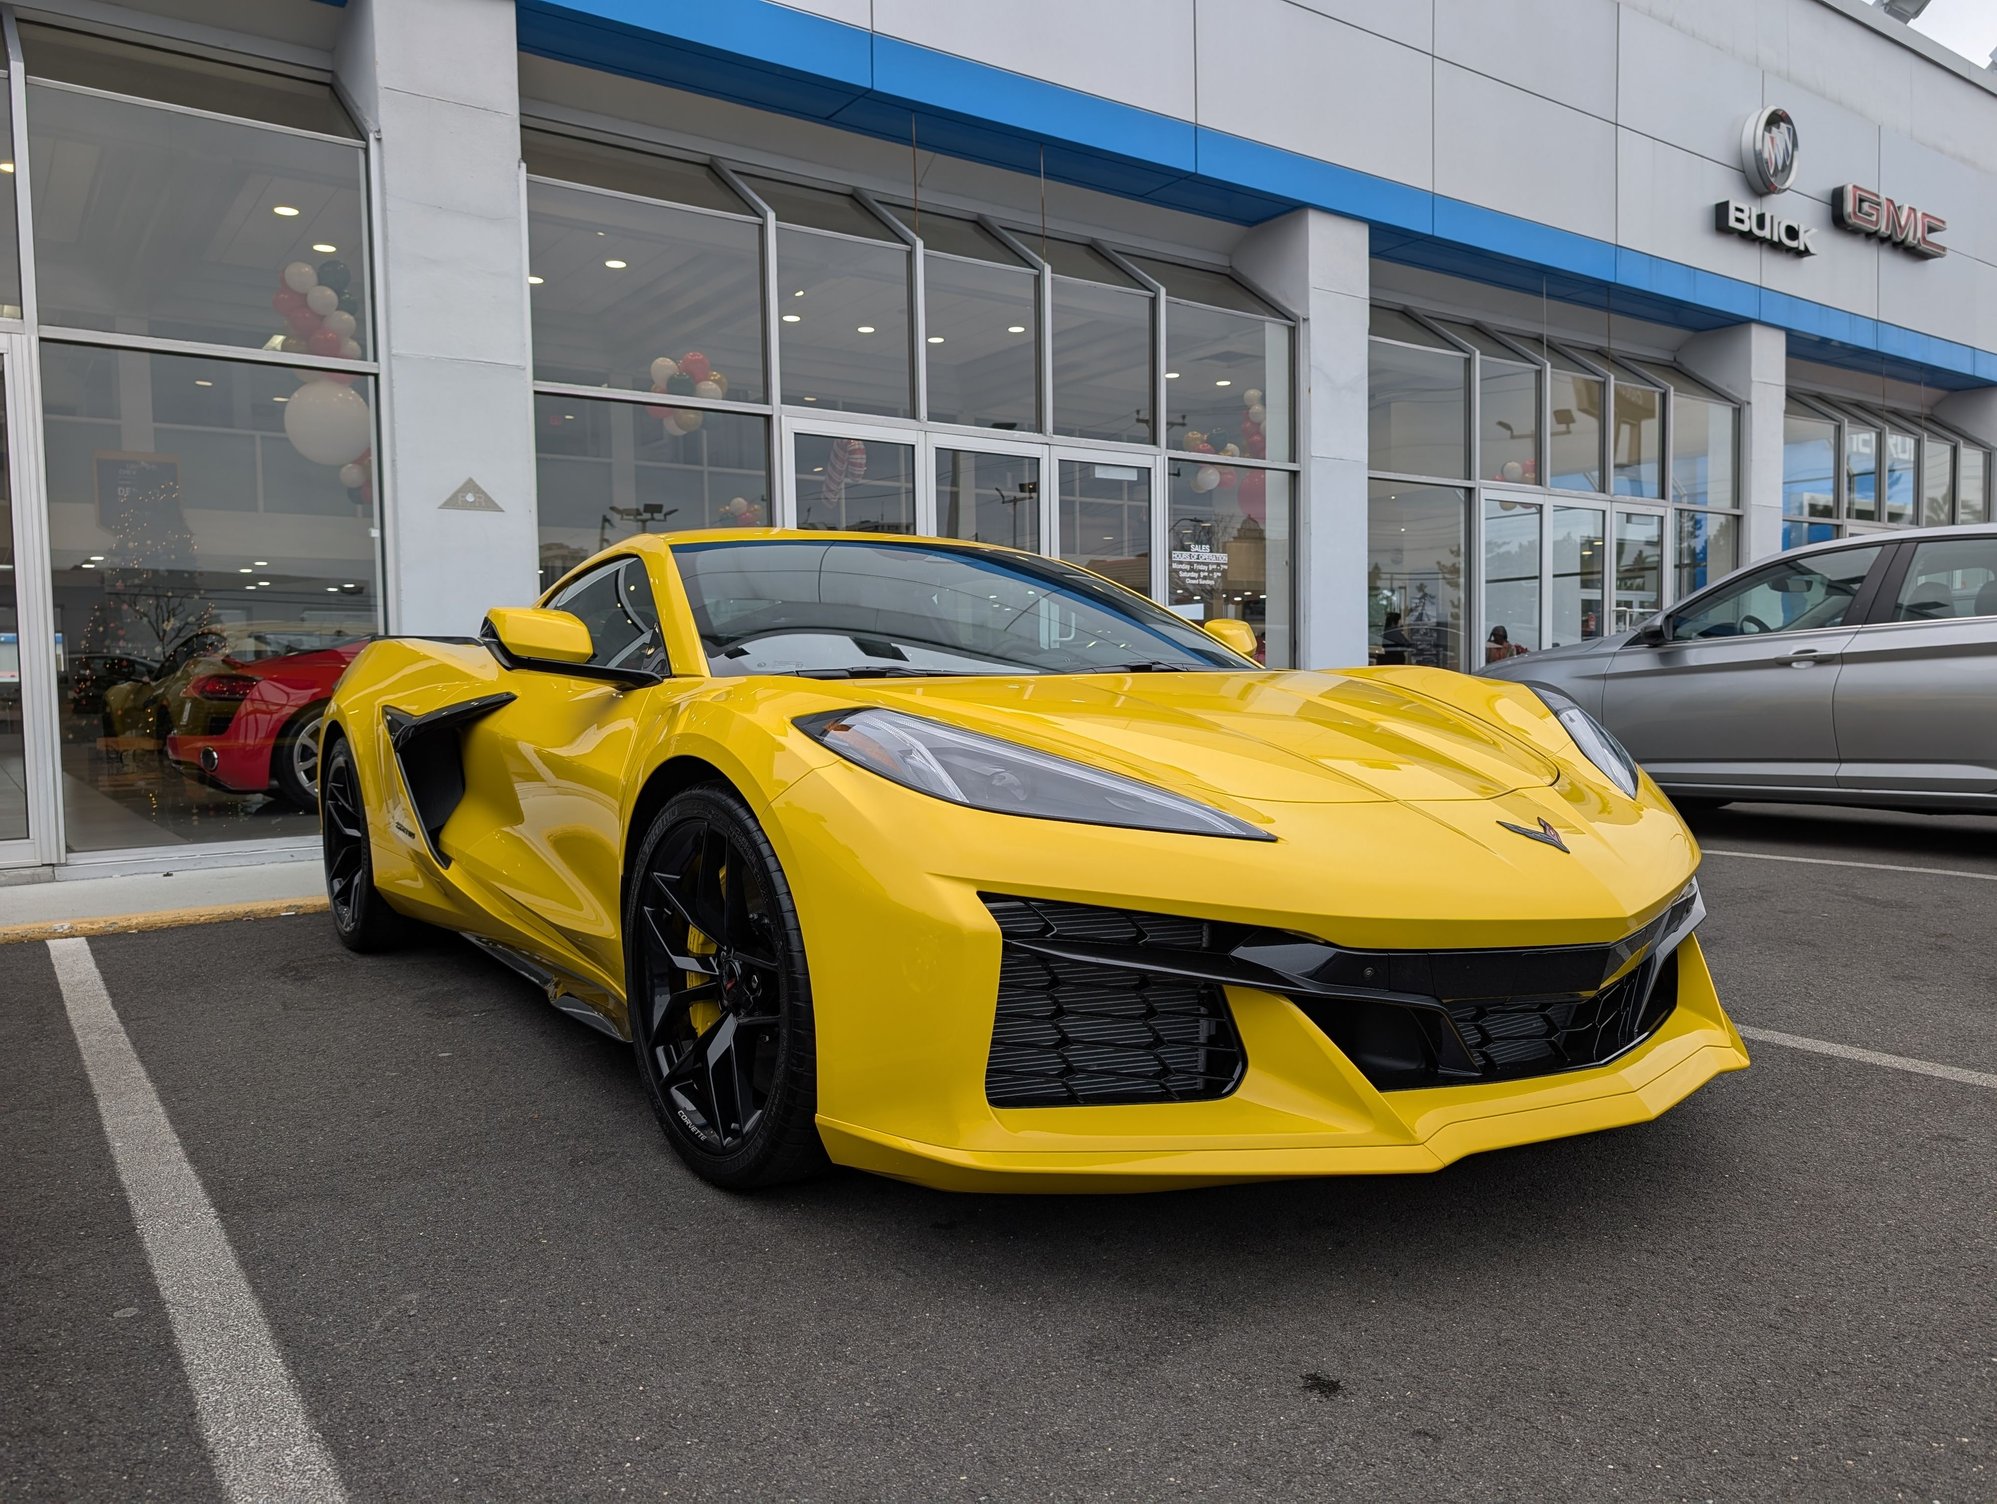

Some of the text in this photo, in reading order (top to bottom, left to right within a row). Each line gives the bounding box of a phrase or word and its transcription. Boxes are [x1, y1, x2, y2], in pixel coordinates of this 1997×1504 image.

[1725, 199, 1818, 256] BUICK
[1840, 183, 1947, 258] GMC
[1172, 552, 1190, 560] HOURS
[1199, 553, 1228, 562] OPERATION
[1190, 544, 1210, 553] SALES
[1194, 563, 1208, 571] Friday
[677, 1110, 708, 1141] CORVETTE
